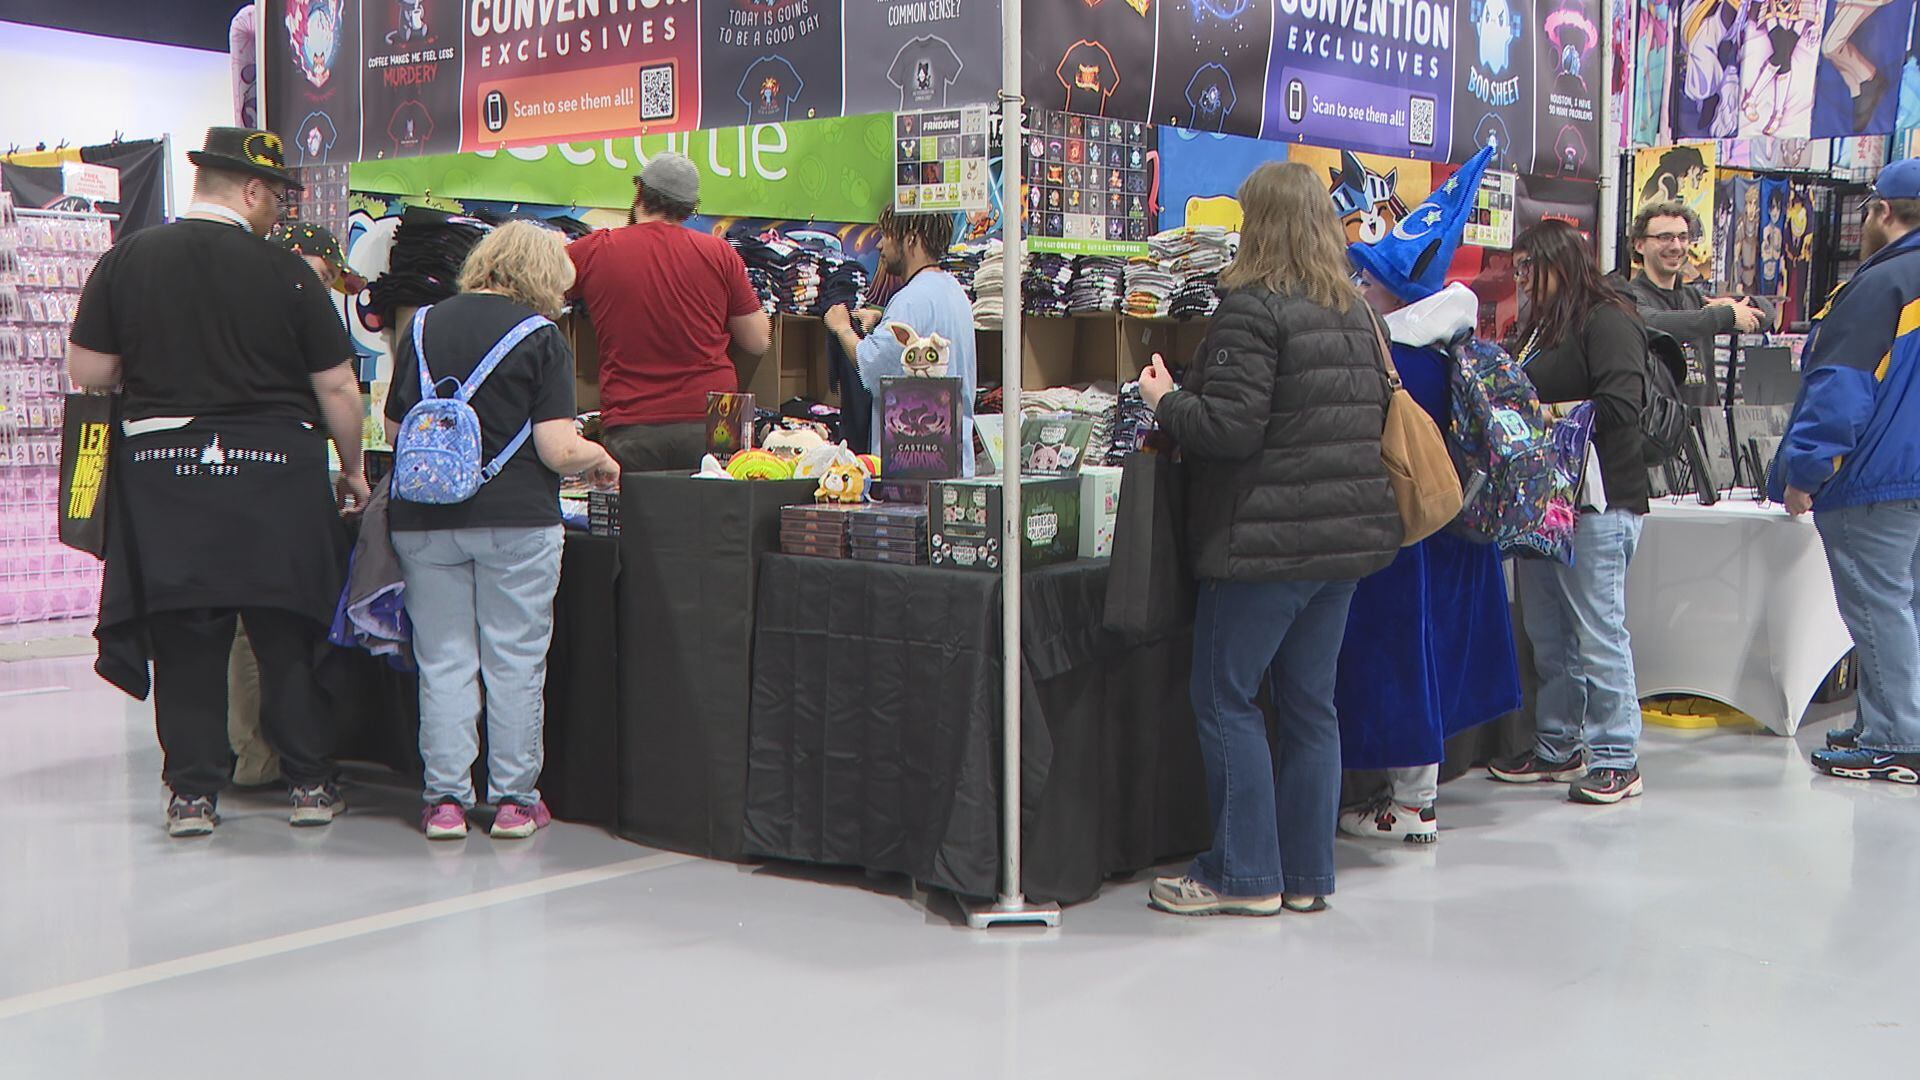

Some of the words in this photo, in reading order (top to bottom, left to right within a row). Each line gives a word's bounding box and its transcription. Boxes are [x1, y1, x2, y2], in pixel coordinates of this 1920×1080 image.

[729, 9, 759, 27] TODAY
[763, 10, 773, 26] IS
[777, 0, 809, 23] GOING
[888, 2, 927, 26] COMMON
[928, 0, 961, 21] SENSE?
[481, 17, 676, 67] EXCLUSIVES
[719, 27, 732, 44] TO
[736, 30, 749, 46] BE
[753, 30, 760, 46] A
[766, 24, 795, 45] GOOD
[799, 13, 820, 36] DAY
[368, 56, 389, 68] COFFEE
[390, 53, 410, 65] MAKES
[411, 52, 421, 63] ME
[422, 50, 438, 61] FEEL
[439, 47, 454, 60] LESS
[1287, 25, 1439, 79] EXCLUSIVES
[383, 63, 438, 88] MURDERY
[1467, 64, 1490, 103] BOO
[1490, 75, 1520, 106] SHEET
[513, 100, 541, 118] Scan
[543, 100, 555, 115] to
[557, 99, 578, 113] see
[580, 92, 612, 111] them
[614, 87, 634, 107] all!
[1312, 95, 1335, 116] Scan
[1337, 102, 1347, 117] to
[1348, 106, 1365, 120] see
[1366, 105, 1388, 124] them
[1389, 109, 1405, 127] all!
[923, 119, 959, 131] FANDOMS
[898, 443, 938, 453] CASTING
